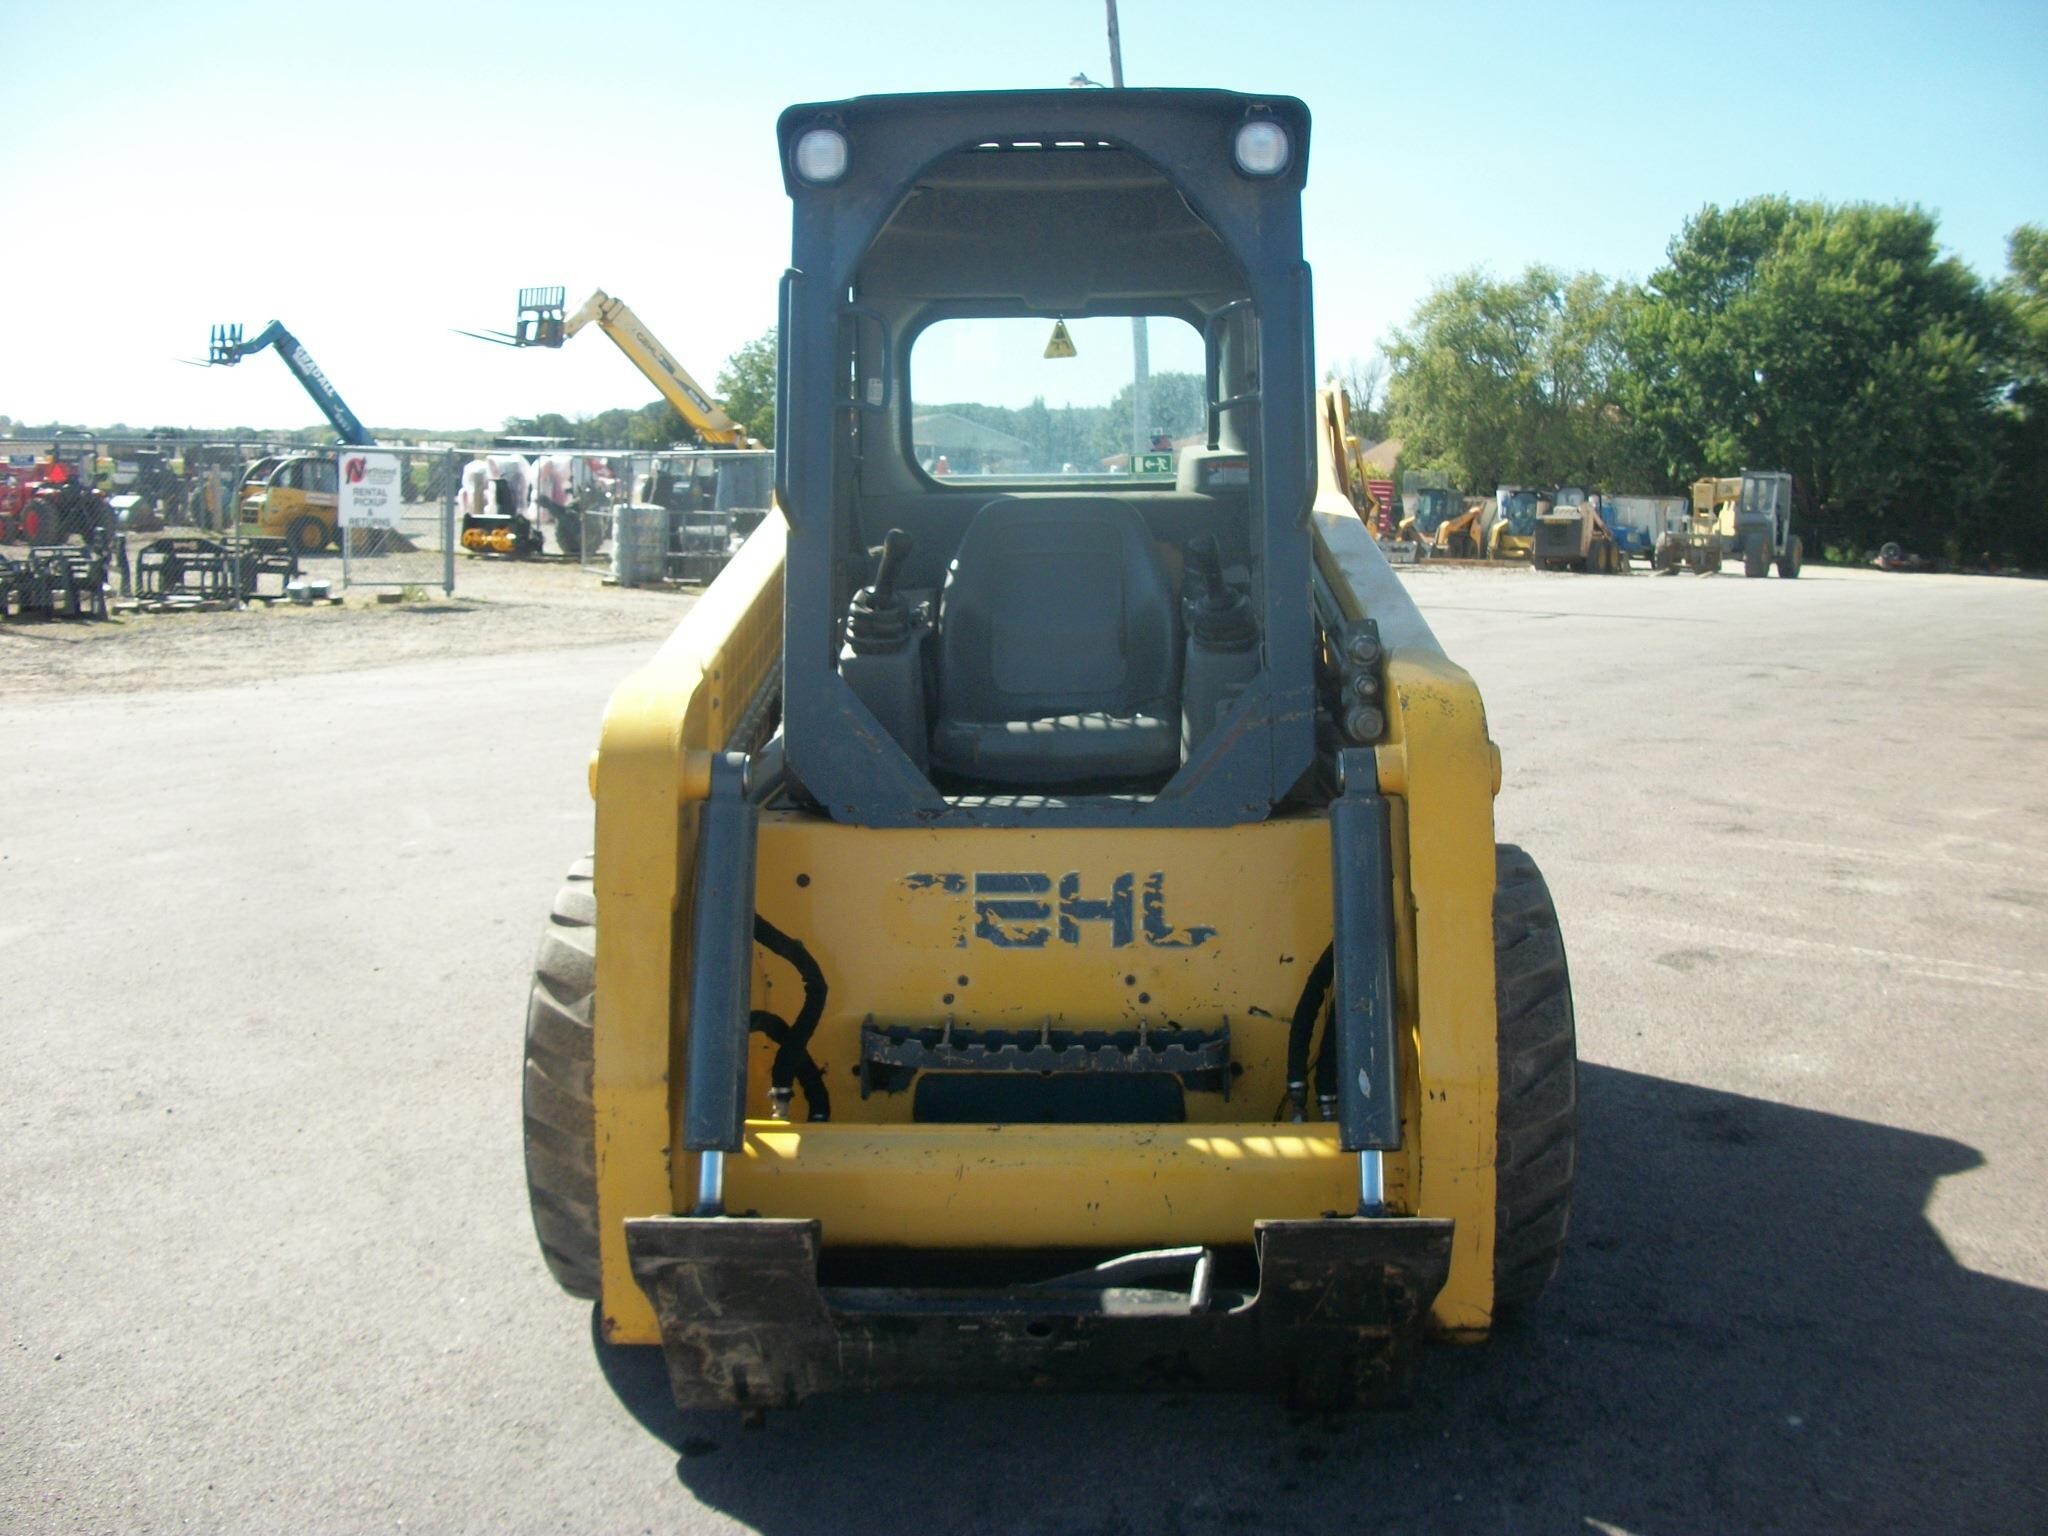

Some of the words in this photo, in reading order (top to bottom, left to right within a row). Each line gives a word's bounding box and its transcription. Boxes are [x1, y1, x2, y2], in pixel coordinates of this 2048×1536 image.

[296, 345, 334, 397] GRADALL
[353, 488, 387, 496] RENTAL
[353, 497, 387, 506] PICKUP
[348, 517, 391, 527] RETURNS
